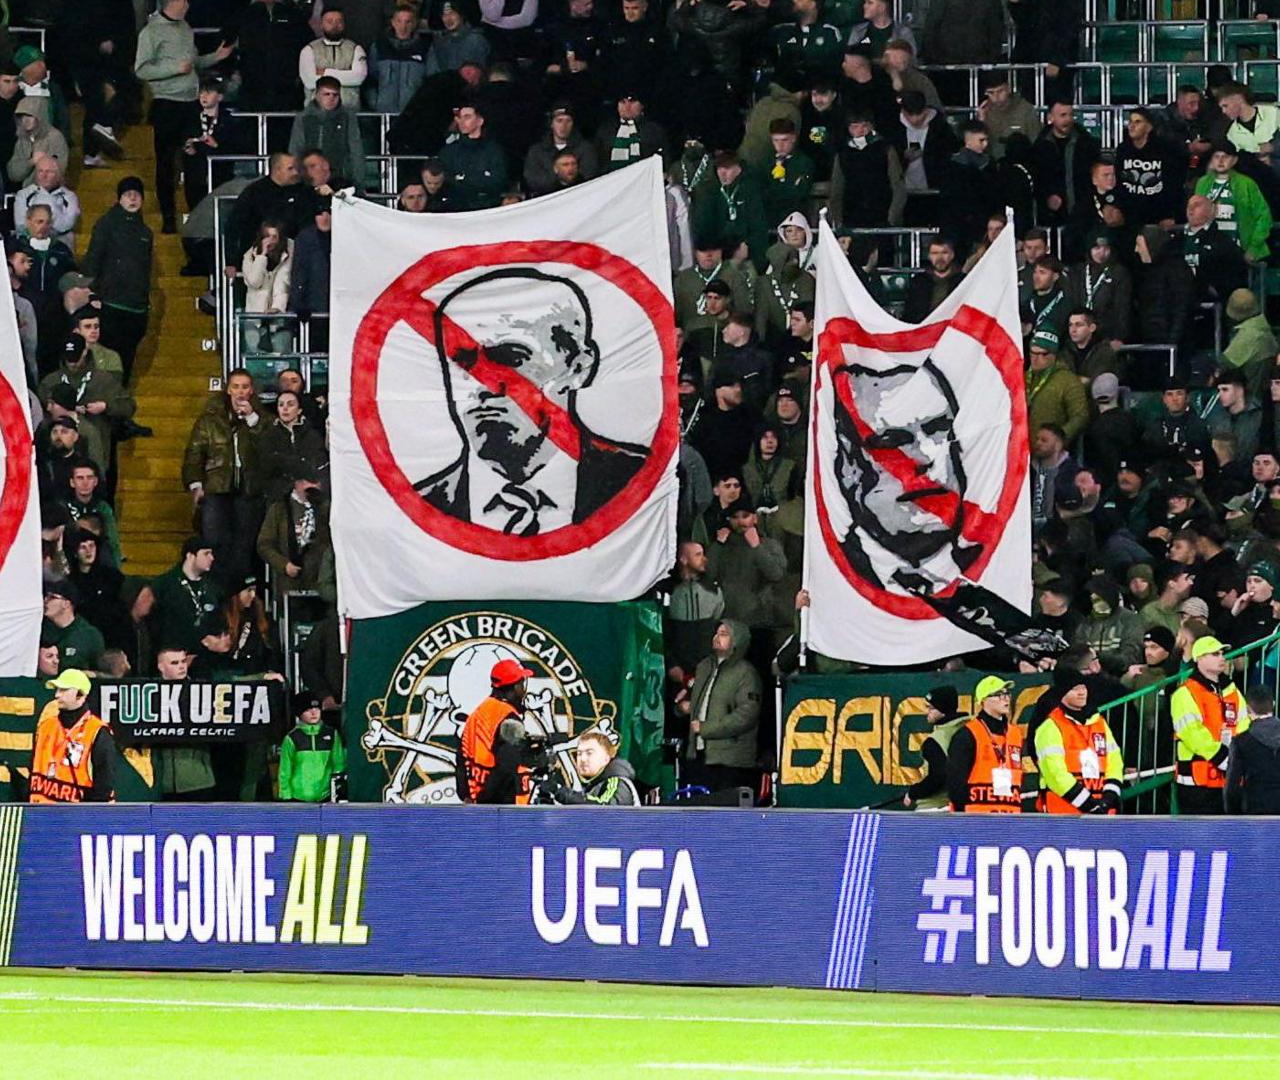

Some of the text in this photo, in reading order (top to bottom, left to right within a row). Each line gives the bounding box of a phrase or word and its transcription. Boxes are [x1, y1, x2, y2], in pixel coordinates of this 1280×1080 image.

[1123, 159, 1162, 171] MOON
[394, 614, 588, 698] GREEN BRIGADE
[100, 683, 271, 725] FUCK UEFA
[189, 728, 237, 737] CELTIC
[80, 833, 368, 945] WELCOME ALL
[531, 846, 709, 947] UEFA
[916, 845, 1232, 972] #FOOTBALL
